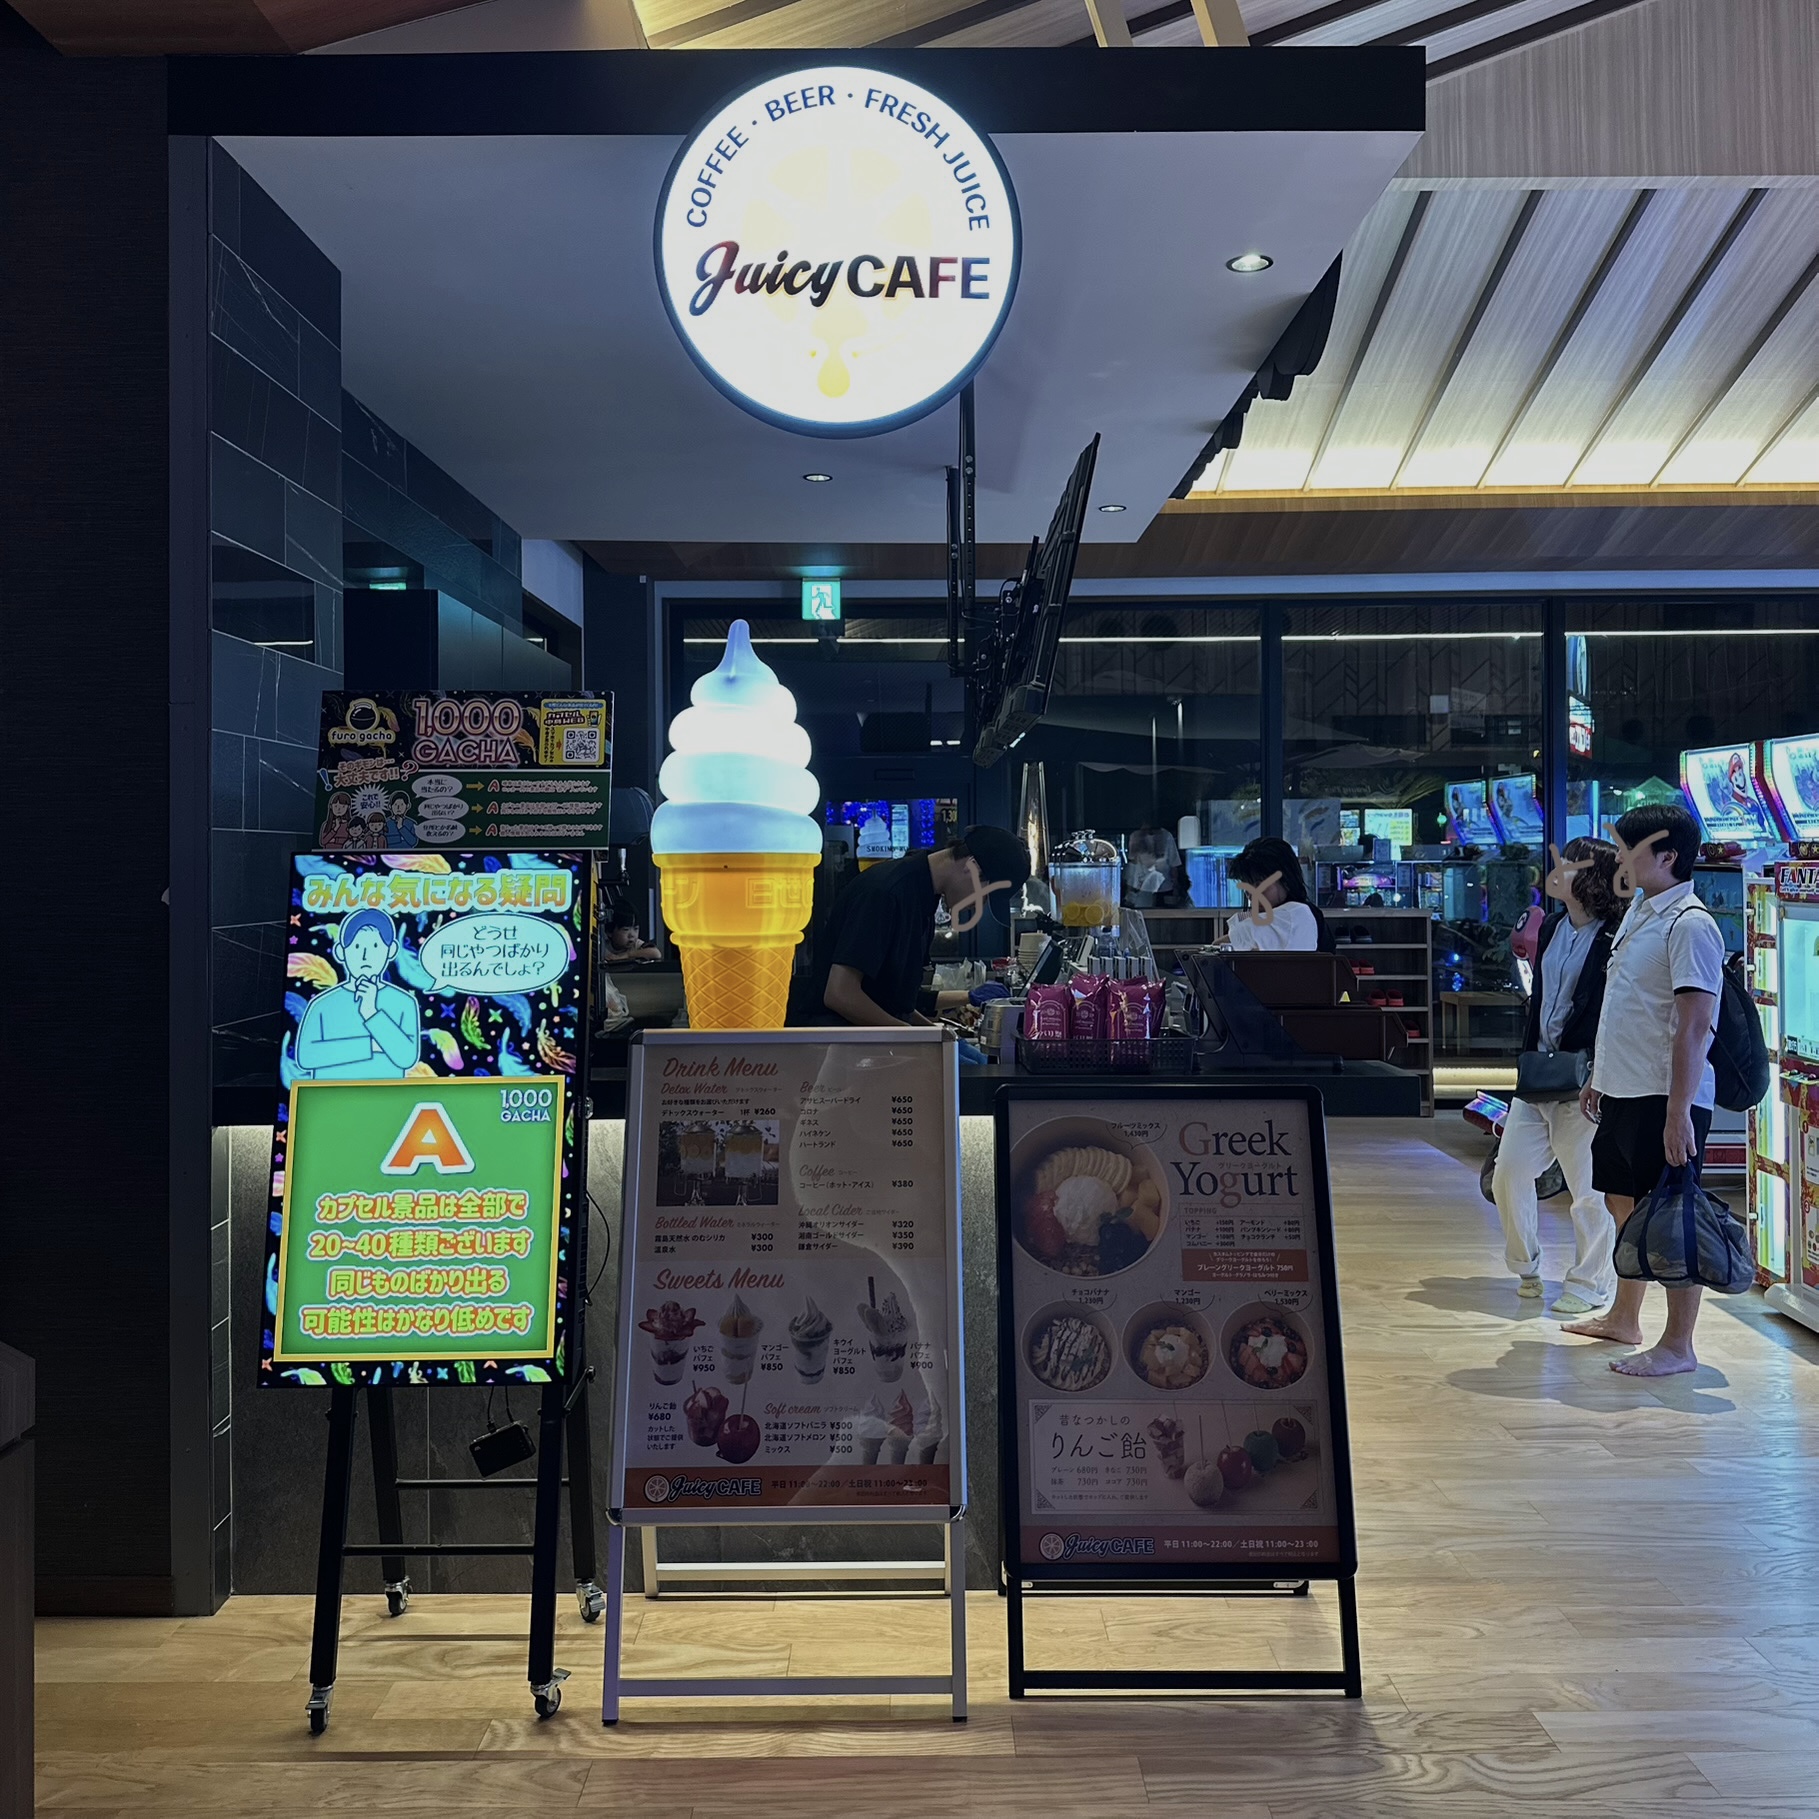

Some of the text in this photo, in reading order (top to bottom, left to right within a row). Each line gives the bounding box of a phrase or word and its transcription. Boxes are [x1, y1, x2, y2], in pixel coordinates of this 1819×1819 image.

[686, 85, 990, 231] COFFEE BEER FRESH JUICE
[689, 240, 990, 316] Juicy CAFE
[414, 699, 522, 737] 1,000
[331, 731, 393, 744] furo gacha
[413, 738, 520, 764] GACHA
[335, 768, 399, 787] 大丈夫です!!
[304, 873, 567, 909] みんな気になる疑問
[473, 926, 517, 941] どうせ
[440, 943, 549, 959] 同じやつばかり
[441, 961, 545, 977] 出るんでしょ?
[663, 1056, 778, 1077] Drink Menu
[661, 1083, 691, 1095] Detox
[694, 1083, 728, 1094] Water
[500, 1089, 552, 1109] 1,000
[500, 1110, 551, 1122] GACHA
[800, 1119, 819, 1127] ギネス
[384, 1105, 471, 1172] A
[800, 1130, 831, 1138] ハイネケン
[1179, 1120, 1292, 1156] Greek
[800, 1141, 836, 1149] ハートランド
[800, 1164, 835, 1182] Coffee
[892, 1180, 913, 1188] ¥380
[1170, 1161, 1299, 1208] Yogurt
[318, 1192, 526, 1221] カプセル景品は全部で
[798, 1204, 829, 1217] Local
[832, 1204, 862, 1217] Cider
[655, 1217, 699, 1229] Bottled
[699, 1216, 734, 1228] Water
[329, 1267, 507, 1297] 同じものばかり出る
[653, 1268, 784, 1289] Sweets Menu
[1264, 1289, 1307, 1297] ベリーミックス
[303, 1305, 532, 1335] 可能性はかなり低めです
[761, 1344, 789, 1352] マンゴー
[833, 1338, 853, 1346] キウイ
[761, 1353, 781, 1361] パフェ
[833, 1347, 866, 1355] ヨーグルト
[761, 1363, 783, 1371] ¥850
[833, 1357, 853, 1365] パフェ
[693, 1364, 715, 1372] ¥950
[833, 1366, 855, 1375] ¥850
[649, 1402, 677, 1410] りんご飴
[764, 1403, 786, 1418] Soft
[788, 1404, 821, 1415] cream
[648, 1412, 671, 1421] ¥680
[1059, 1414, 1130, 1426] 昔なつかしの
[764, 1421, 853, 1430] 北海道ソフトバニラ ¥500
[764, 1433, 853, 1442] 北海道ソフトメロン ¥500
[764, 1445, 853, 1454] ミックス ¥500
[1052, 1432, 1147, 1459] りんご飴
[670, 1475, 717, 1499] Juicy
[718, 1478, 761, 1495] CAFE
[1064, 1533, 1111, 1560] Juicy
[1110, 1538, 1154, 1554] CAFE
[1163, 1540, 1179, 1549] 平日
